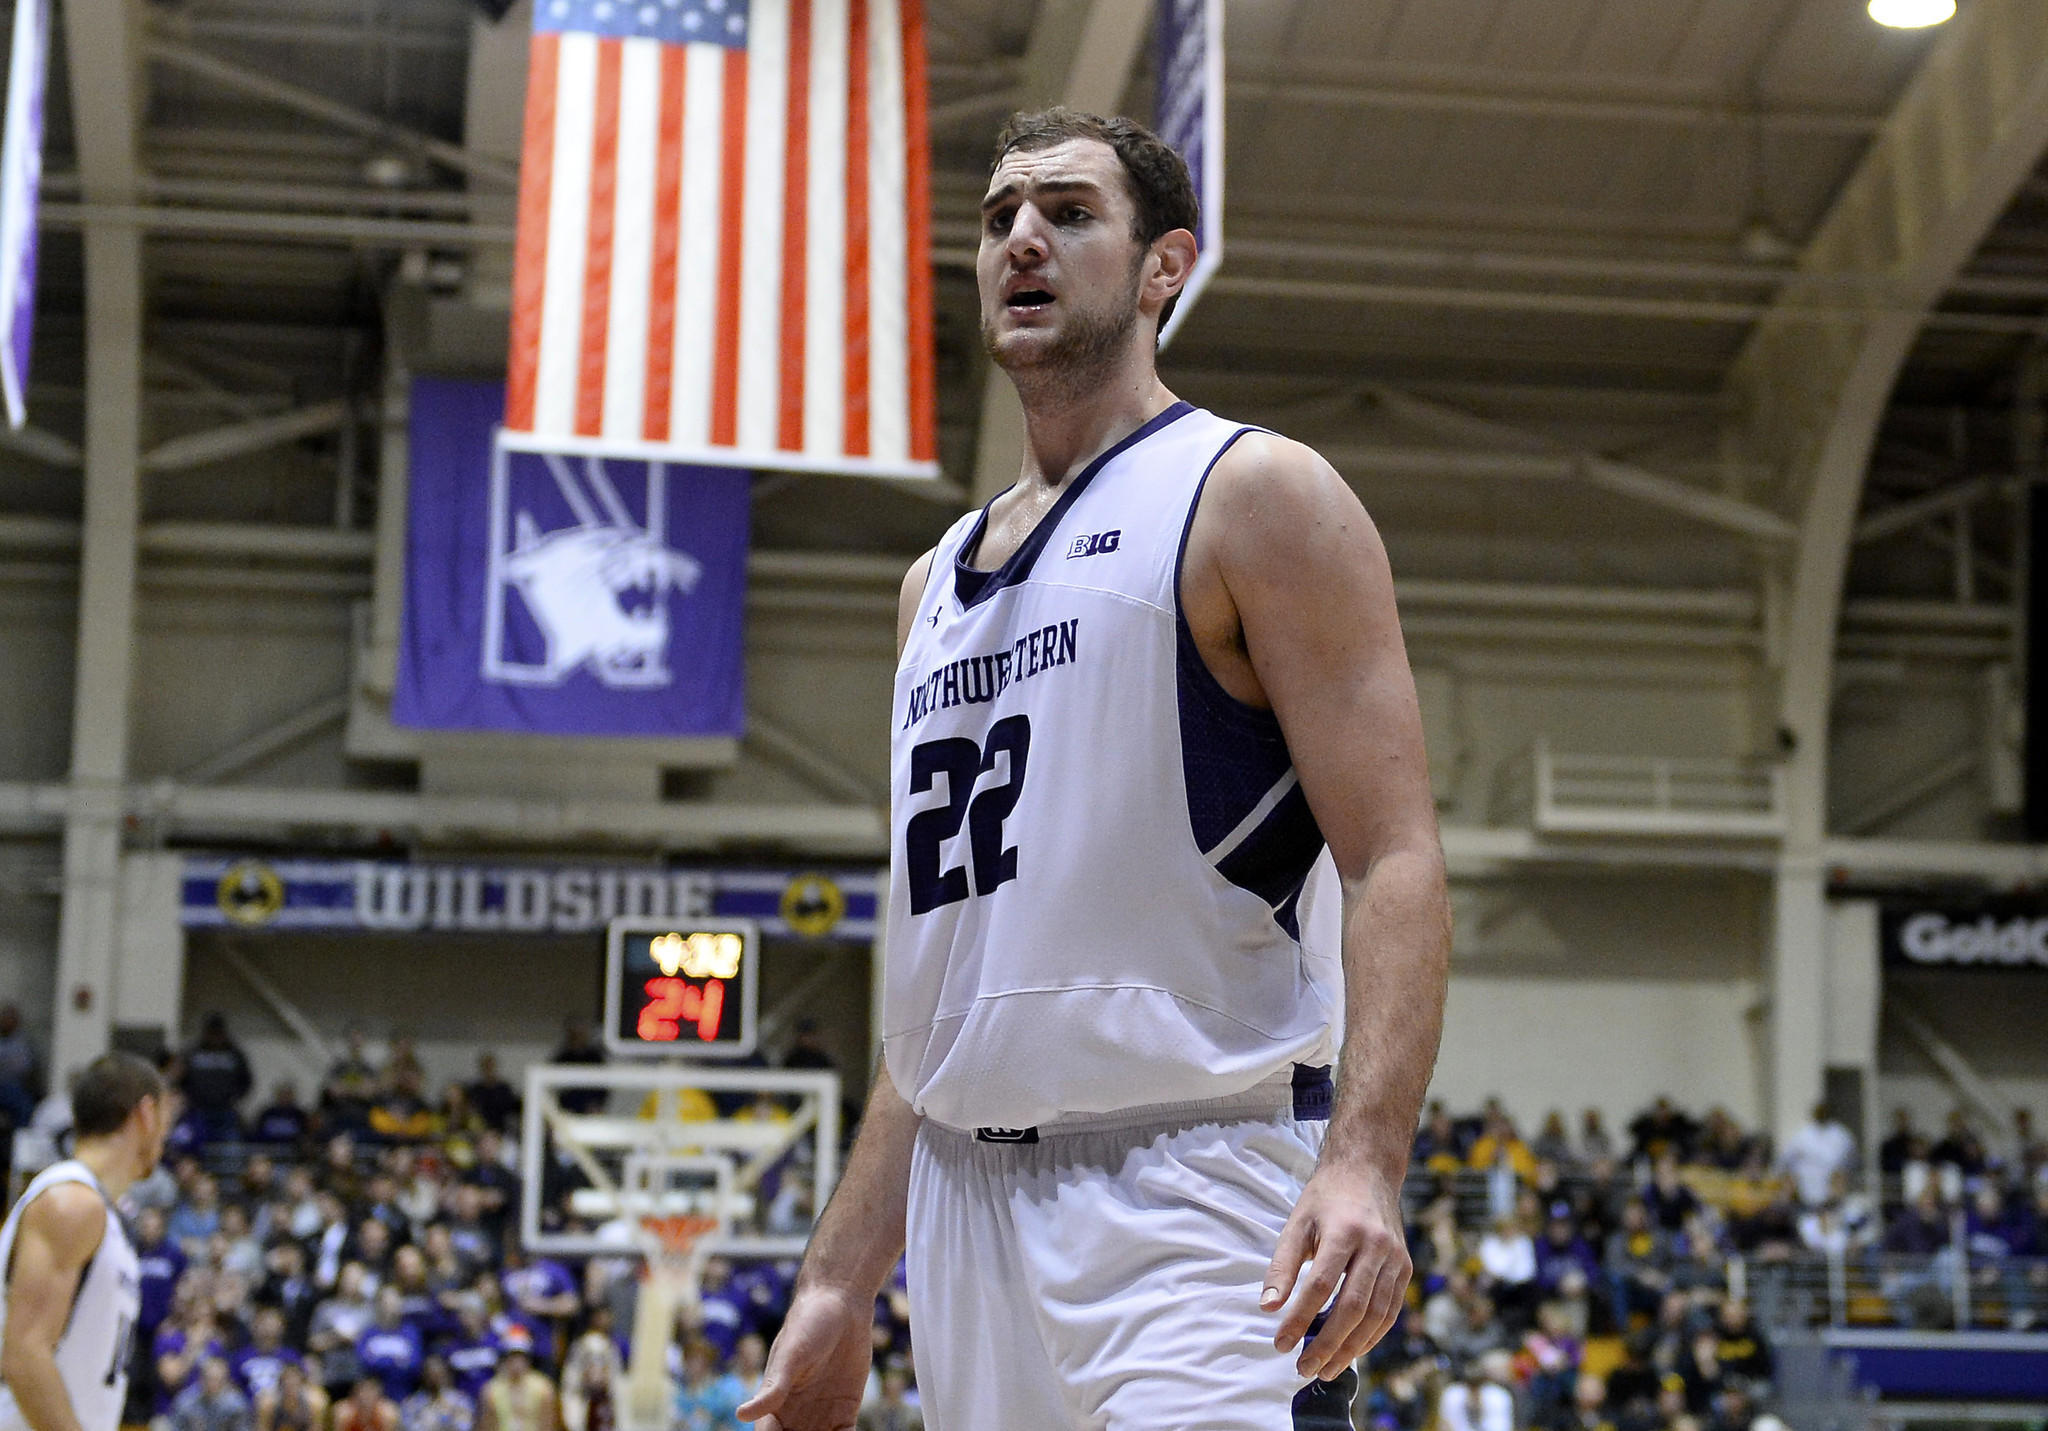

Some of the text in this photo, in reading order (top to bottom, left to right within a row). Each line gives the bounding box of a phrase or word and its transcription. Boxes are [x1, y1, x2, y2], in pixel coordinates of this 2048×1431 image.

[903, 618, 1079, 731] NTHWETERN
[906, 714, 1031, 917] 22
[355, 865, 714, 930] WILDSIDE
[637, 977, 725, 1042] 24
